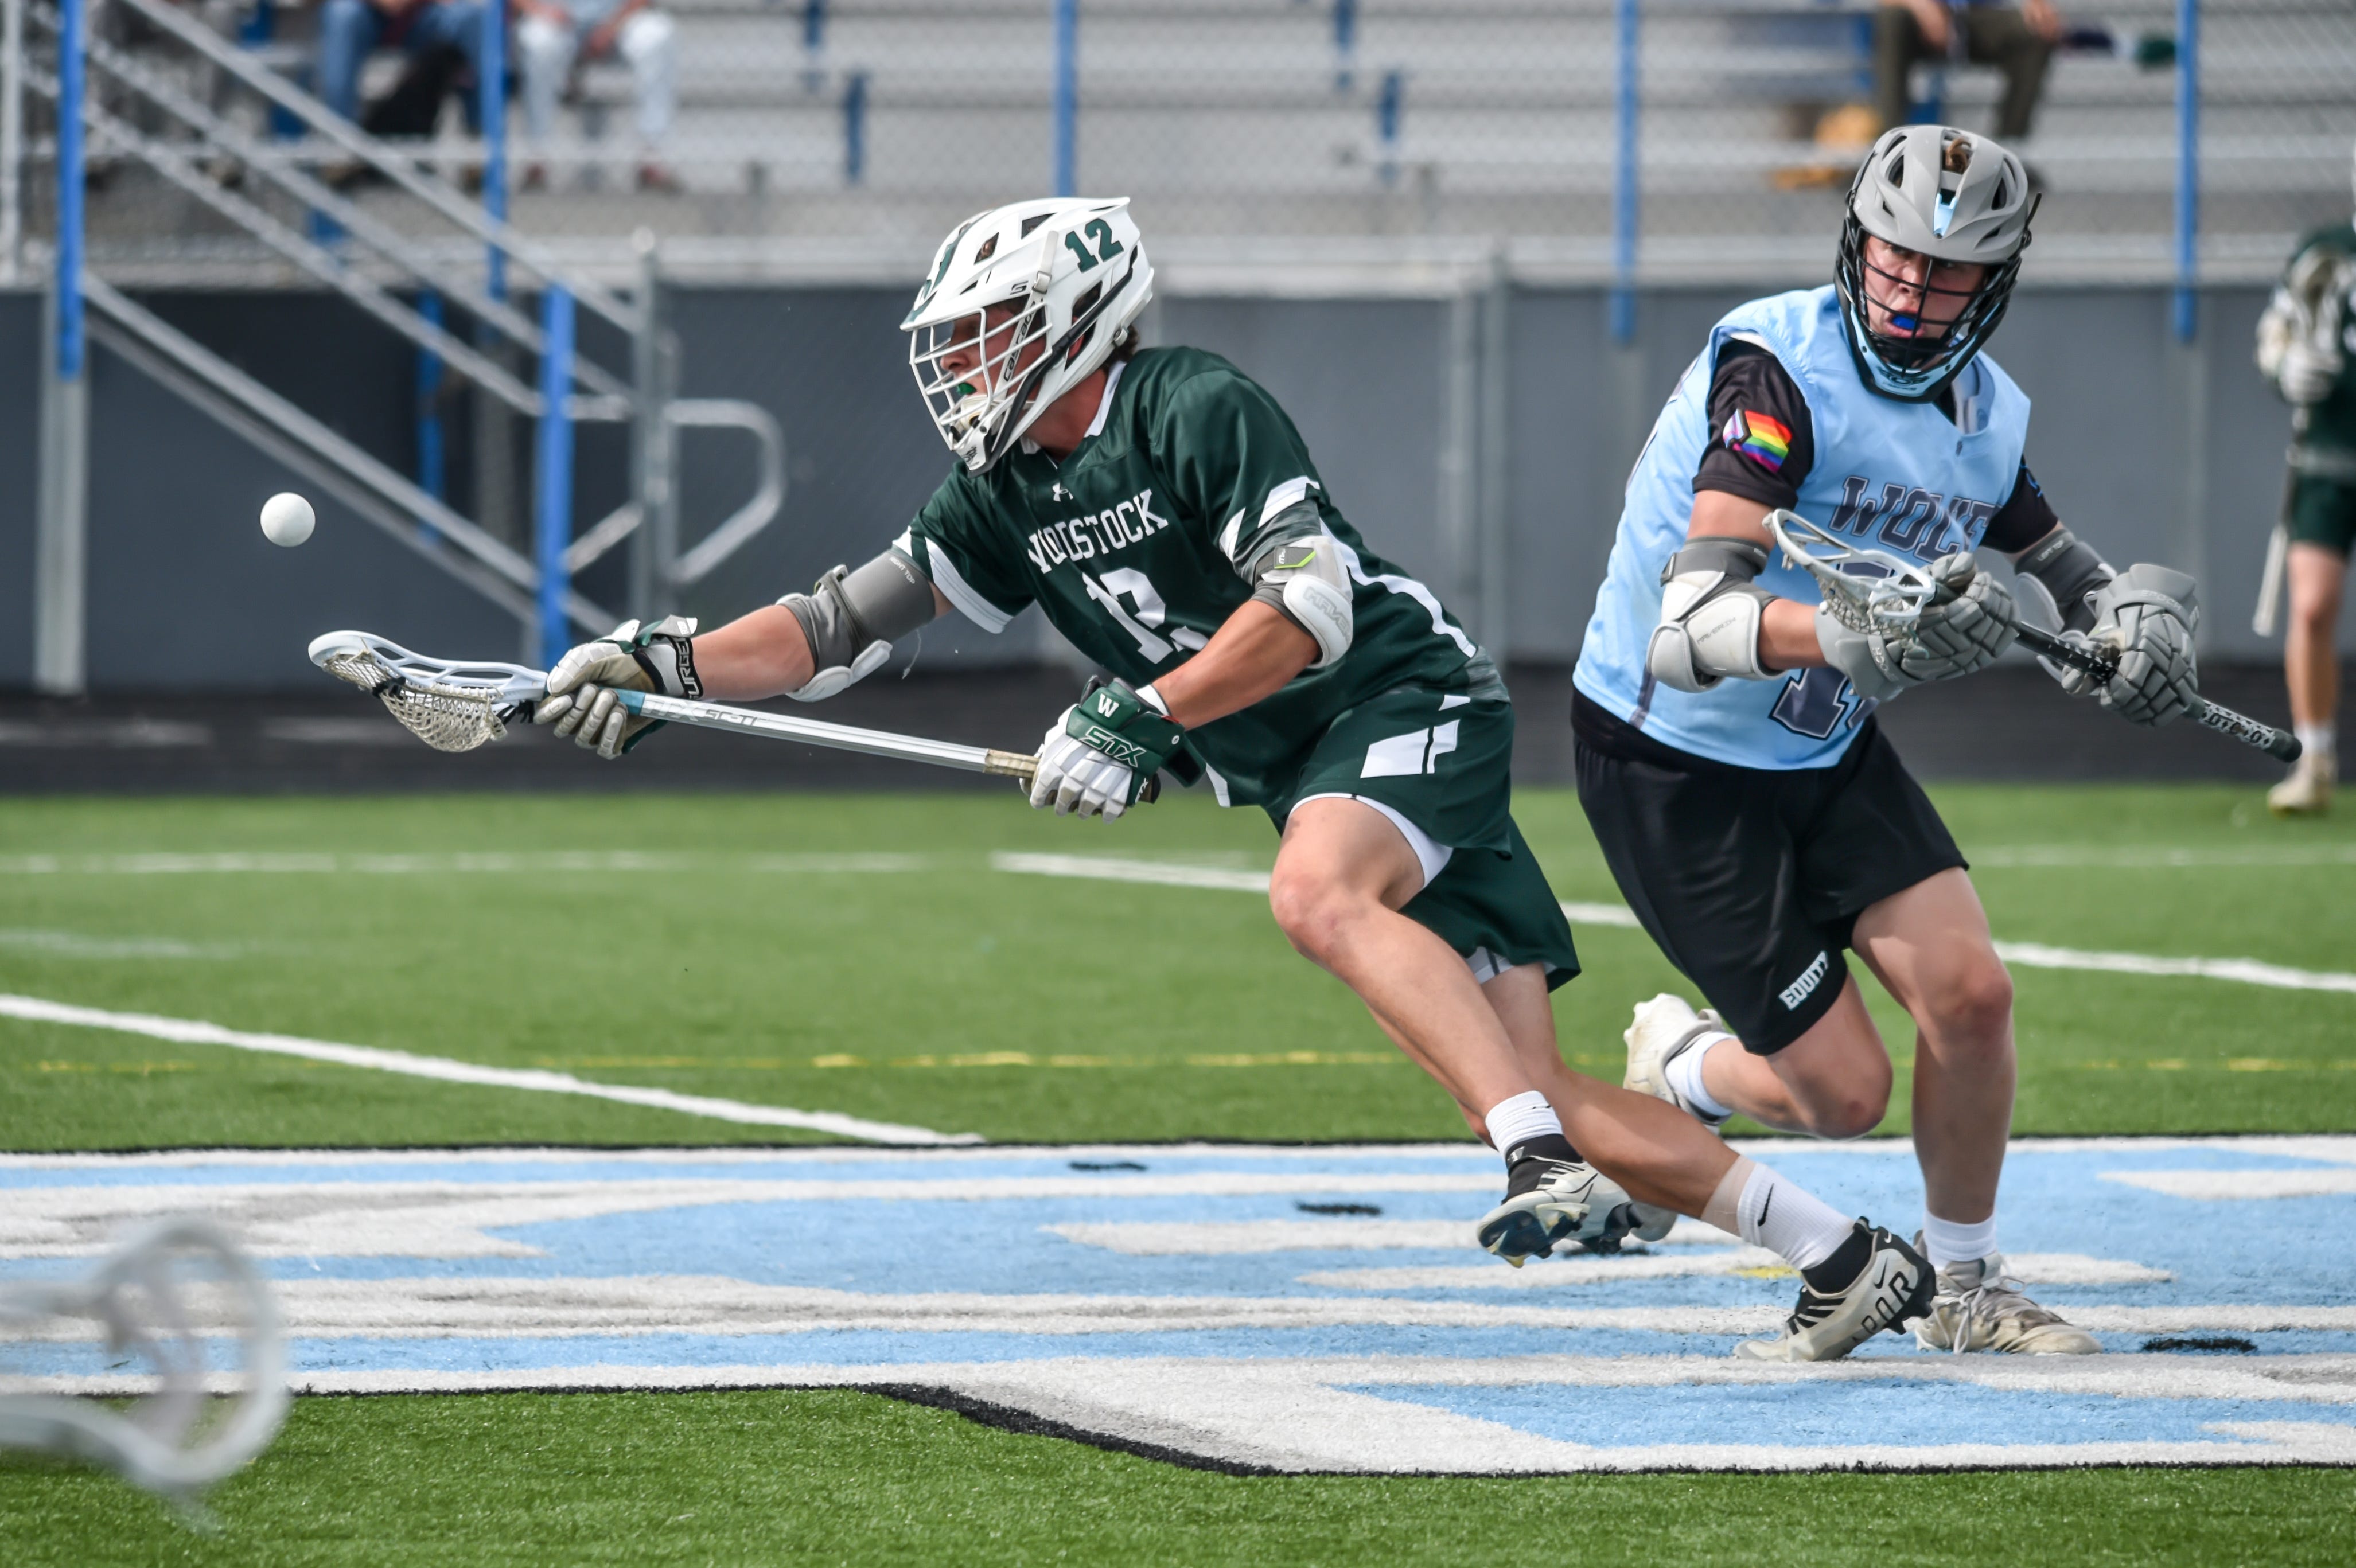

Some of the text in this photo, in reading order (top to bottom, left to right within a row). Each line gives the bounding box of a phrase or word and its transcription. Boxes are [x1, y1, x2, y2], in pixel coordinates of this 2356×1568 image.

[1065, 218, 1124, 274] 12
[889, 556, 916, 584] RIGHT TOP
[2141, 590, 2182, 611] EPOCH
[1097, 693, 1120, 718] W
[1078, 725, 1146, 768] STX
[1778, 950, 1828, 1010] EQUITY
